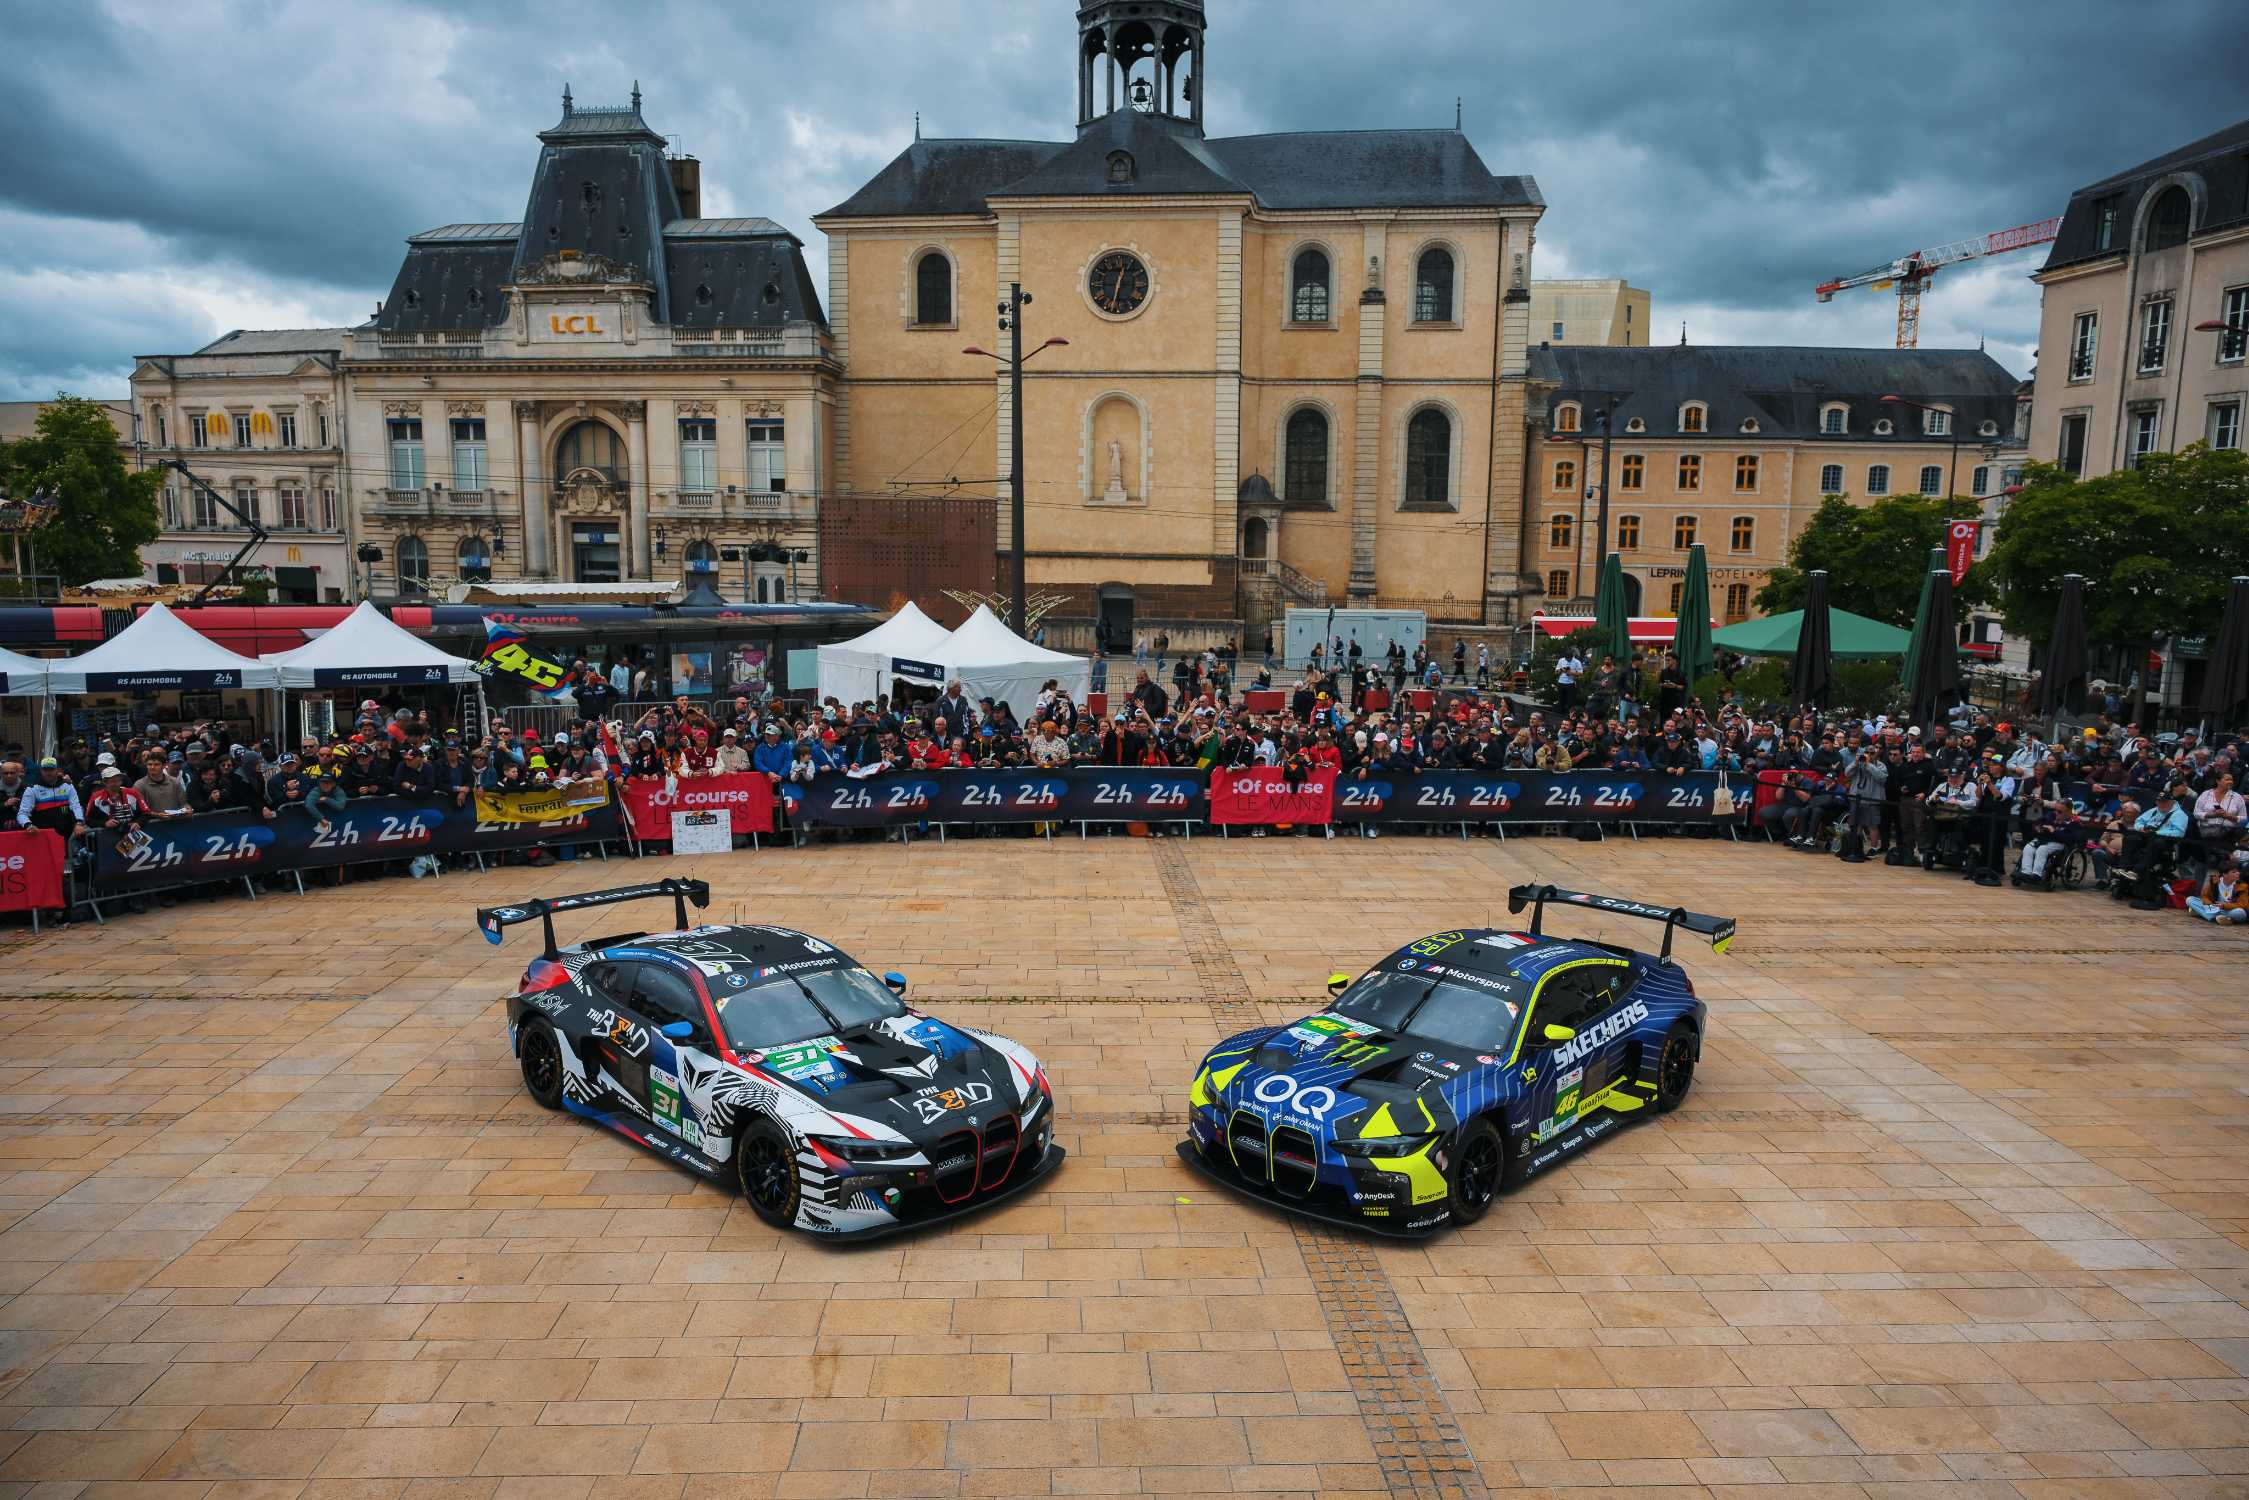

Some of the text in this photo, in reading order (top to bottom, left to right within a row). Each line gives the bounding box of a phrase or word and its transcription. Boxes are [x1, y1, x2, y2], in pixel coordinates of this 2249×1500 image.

[551, 315, 604, 334] LCL
[1704, 569, 1747, 578] HOTEL
[130, 676, 182, 684] AUTOMOBILE
[352, 672, 398, 680] AUTOMOBILE
[684, 790, 749, 806] course
[831, 787, 872, 809] 24h
[888, 785, 926, 808] 24h
[962, 784, 1003, 806] 24h
[1015, 783, 1056, 805] 24h
[1093, 783, 1133, 804] 24h
[1147, 783, 1185, 804] 24h
[1237, 795, 1322, 811] LE MANS
[1342, 785, 1380, 806] 24h
[1417, 785, 1456, 806] 24h
[1470, 785, 1508, 806] 24h
[1545, 786, 1581, 806] 24h
[1593, 785, 1632, 806] 24h
[1667, 787, 1704, 807] 24h
[309, 815, 426, 849] 24h 24h
[201, 833, 256, 862] 24h
[778, 955, 839, 973] Motorsport
[1446, 968, 1512, 993] Motorsport
[587, 1008, 603, 1022] THE
[1553, 999, 1649, 1072] SKECHERS
[775, 1048, 818, 1069] 31
[1412, 1062, 1450, 1081] Motorsport
[917, 1085, 940, 1097] THE
[1254, 1074, 1336, 1122] OQ
[653, 1088, 679, 1119] 31
[1300, 1119, 1321, 1132] OMAN
[1363, 1192, 1396, 1201] AnyDesk
[797, 1215, 843, 1233] GOODYEAR
[1407, 1210, 1450, 1229] GOODYEAR
